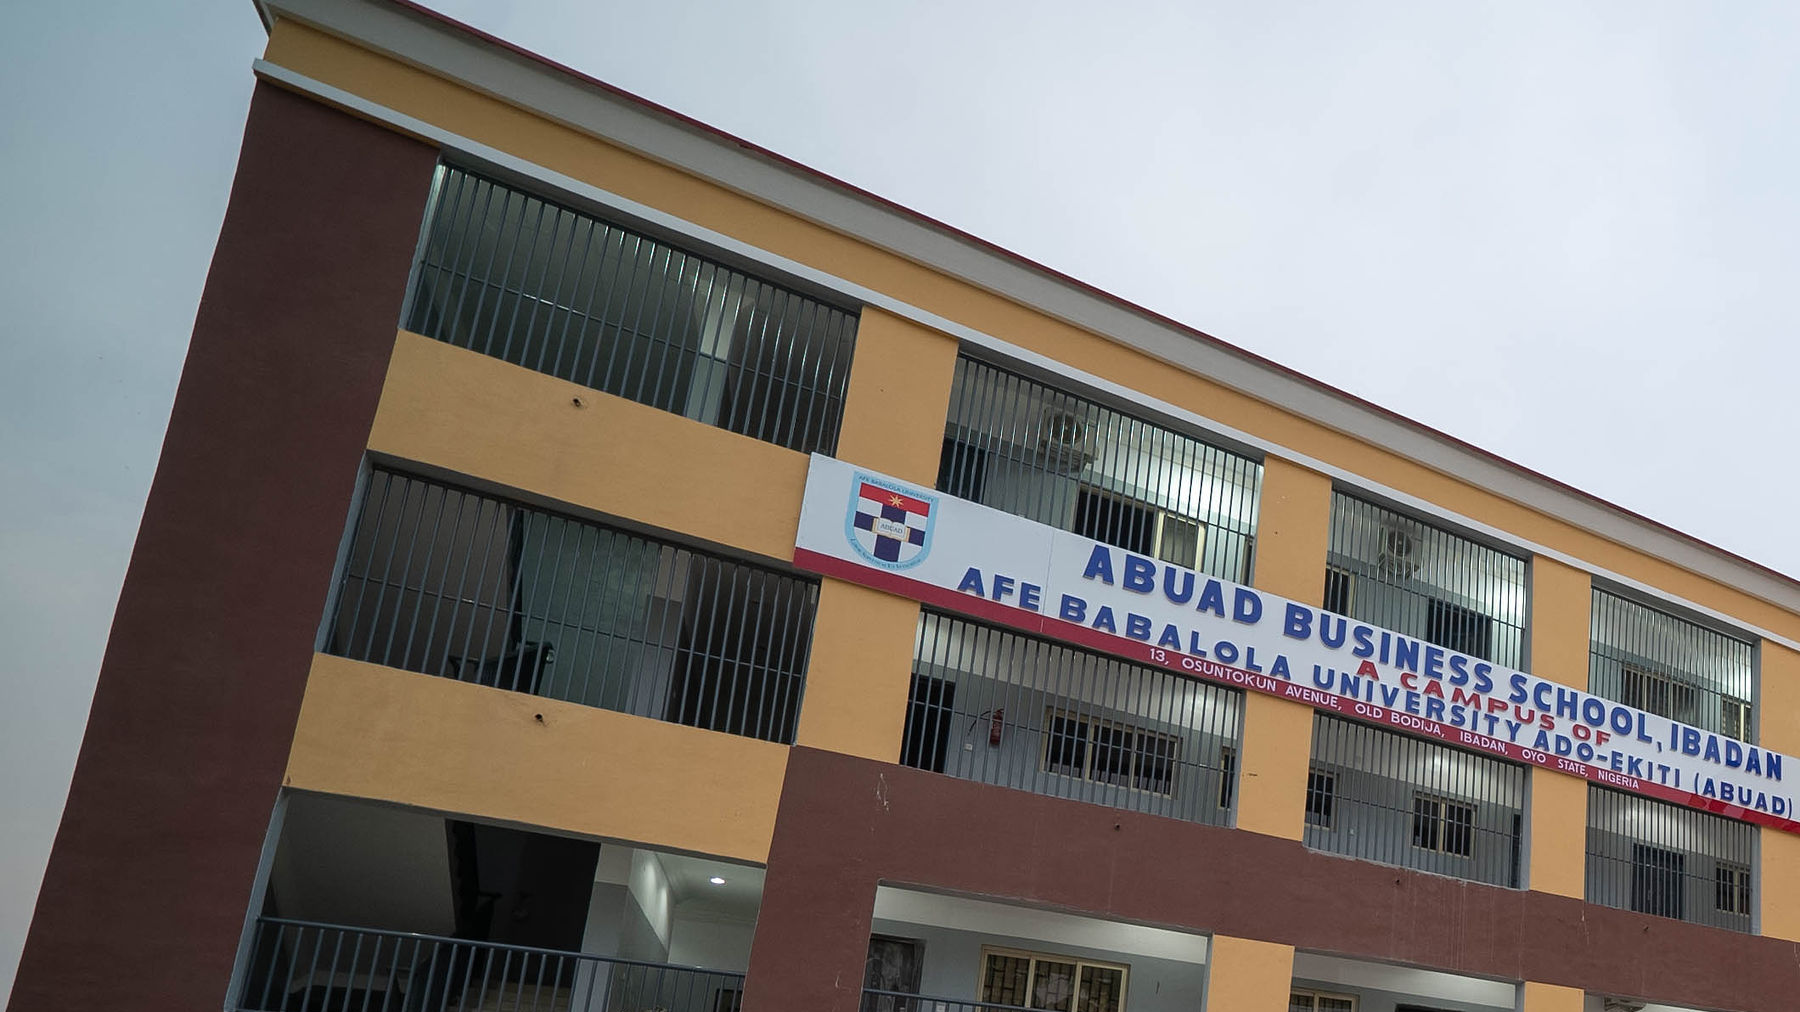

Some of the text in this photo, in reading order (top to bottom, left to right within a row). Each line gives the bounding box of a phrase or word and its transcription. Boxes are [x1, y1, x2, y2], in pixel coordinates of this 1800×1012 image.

[957, 567, 1793, 819] AFE BABALOLA UNIVERSITY ADO-EKITI (ABUAD)
[1083, 544, 1783, 781] ABUAD BUSINESS SCHOOL, IBADAN
[1150, 648, 1639, 790] 13, OSUNTOKUN AVENUE, OLD BODIJA, IBADAN, OYO STATE, NIGERIA
[1356, 660, 1611, 746] A CAMPUS OF
